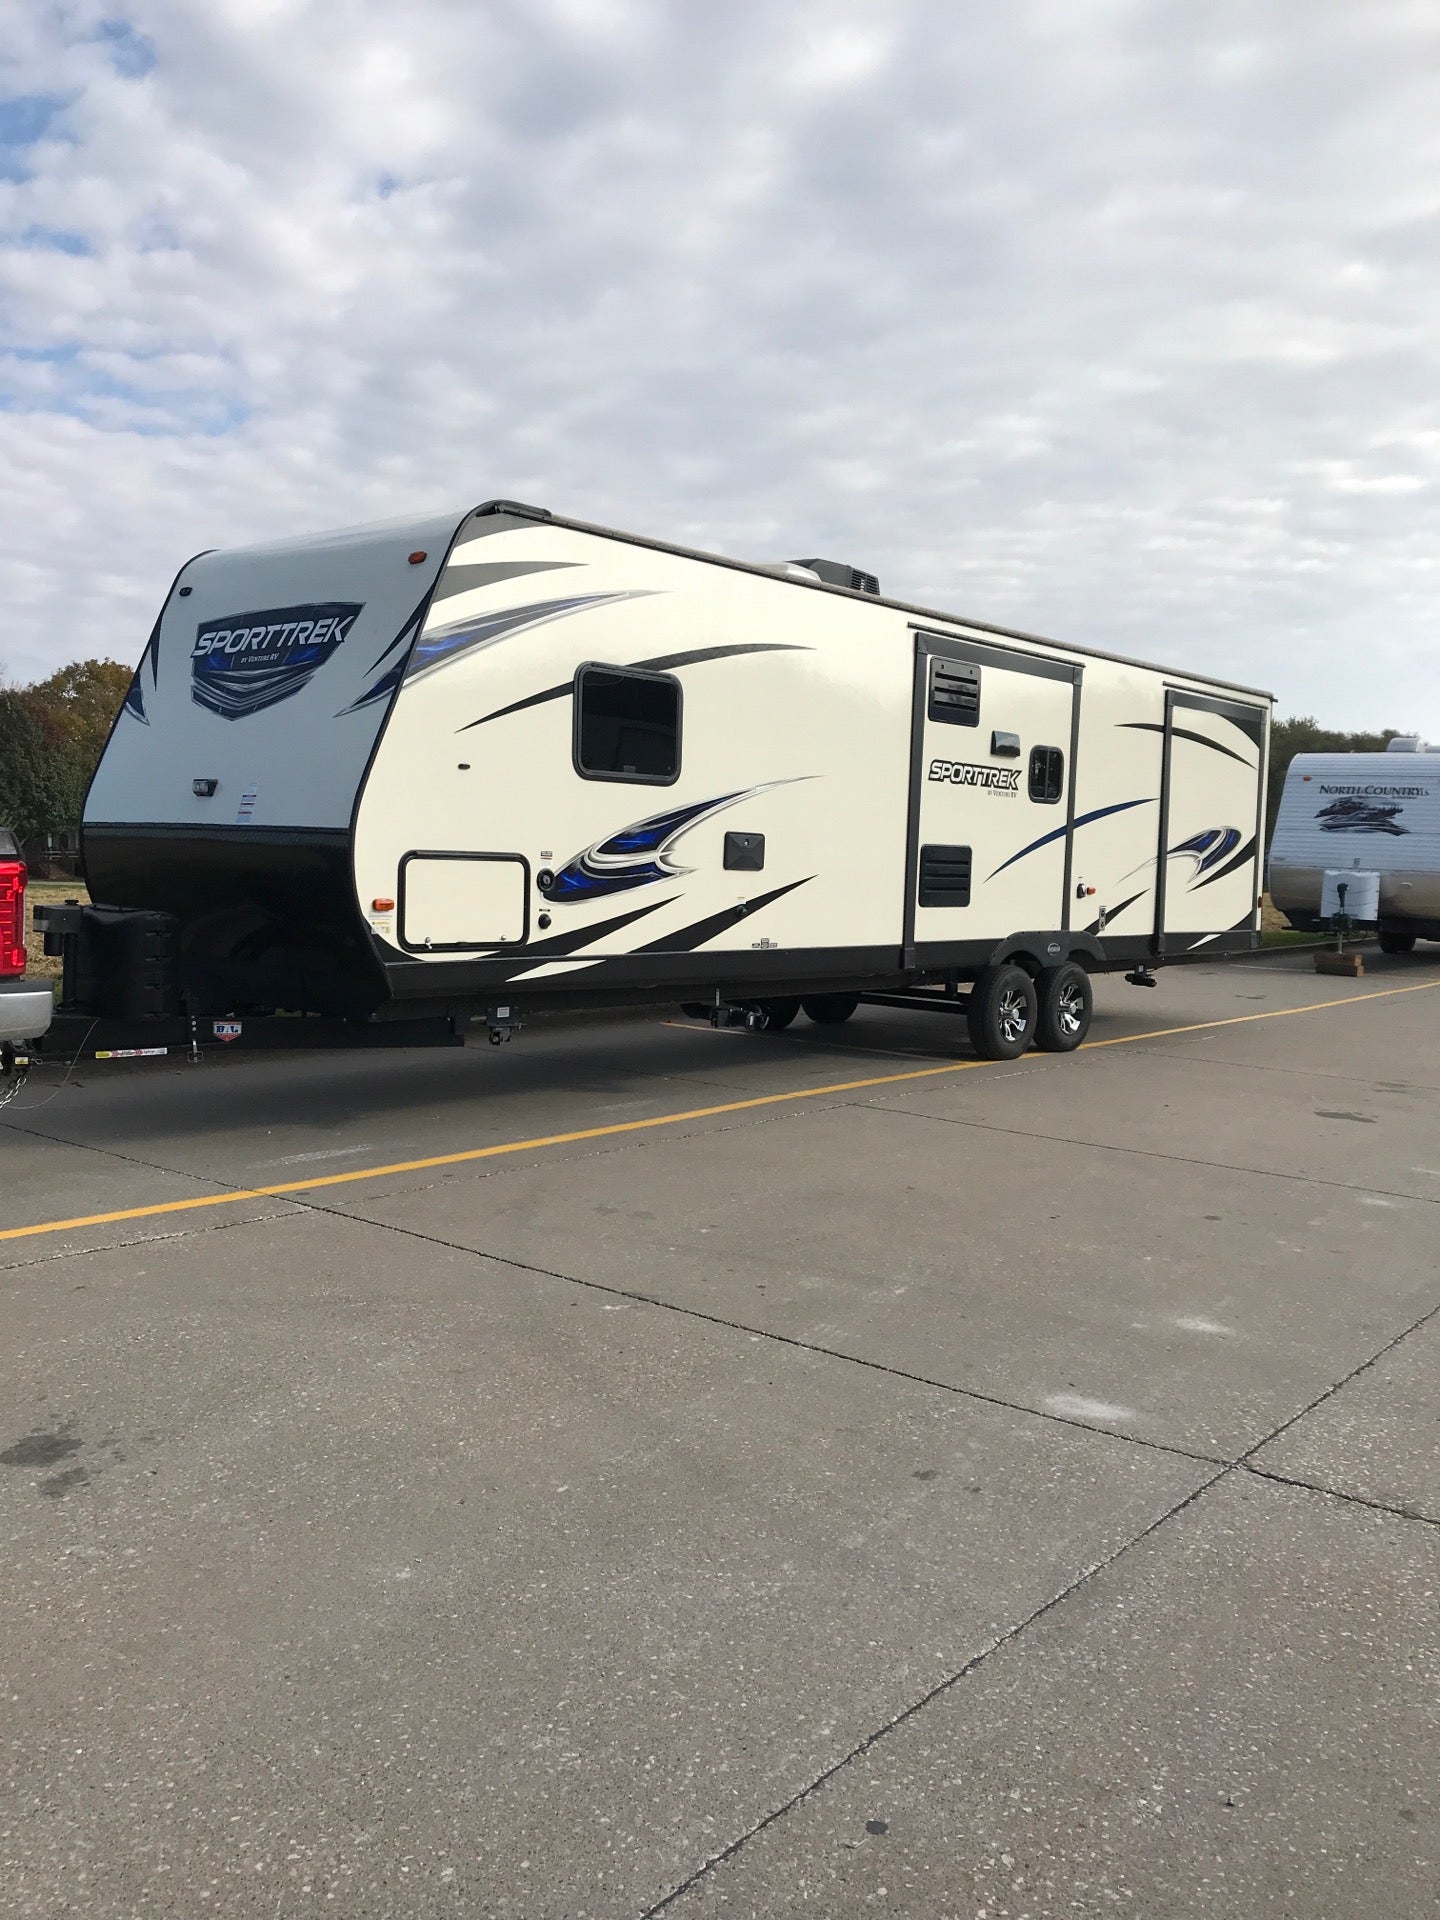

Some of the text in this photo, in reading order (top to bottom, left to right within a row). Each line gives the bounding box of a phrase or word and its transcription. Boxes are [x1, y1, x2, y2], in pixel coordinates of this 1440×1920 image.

[192, 615, 354, 657] SPORTTREK
[270, 653, 280, 661] RV
[929, 759, 1021, 790] SPORTTREK
[1319, 785, 1361, 795] NORTH
[1364, 785, 1422, 796] COUNTRY
